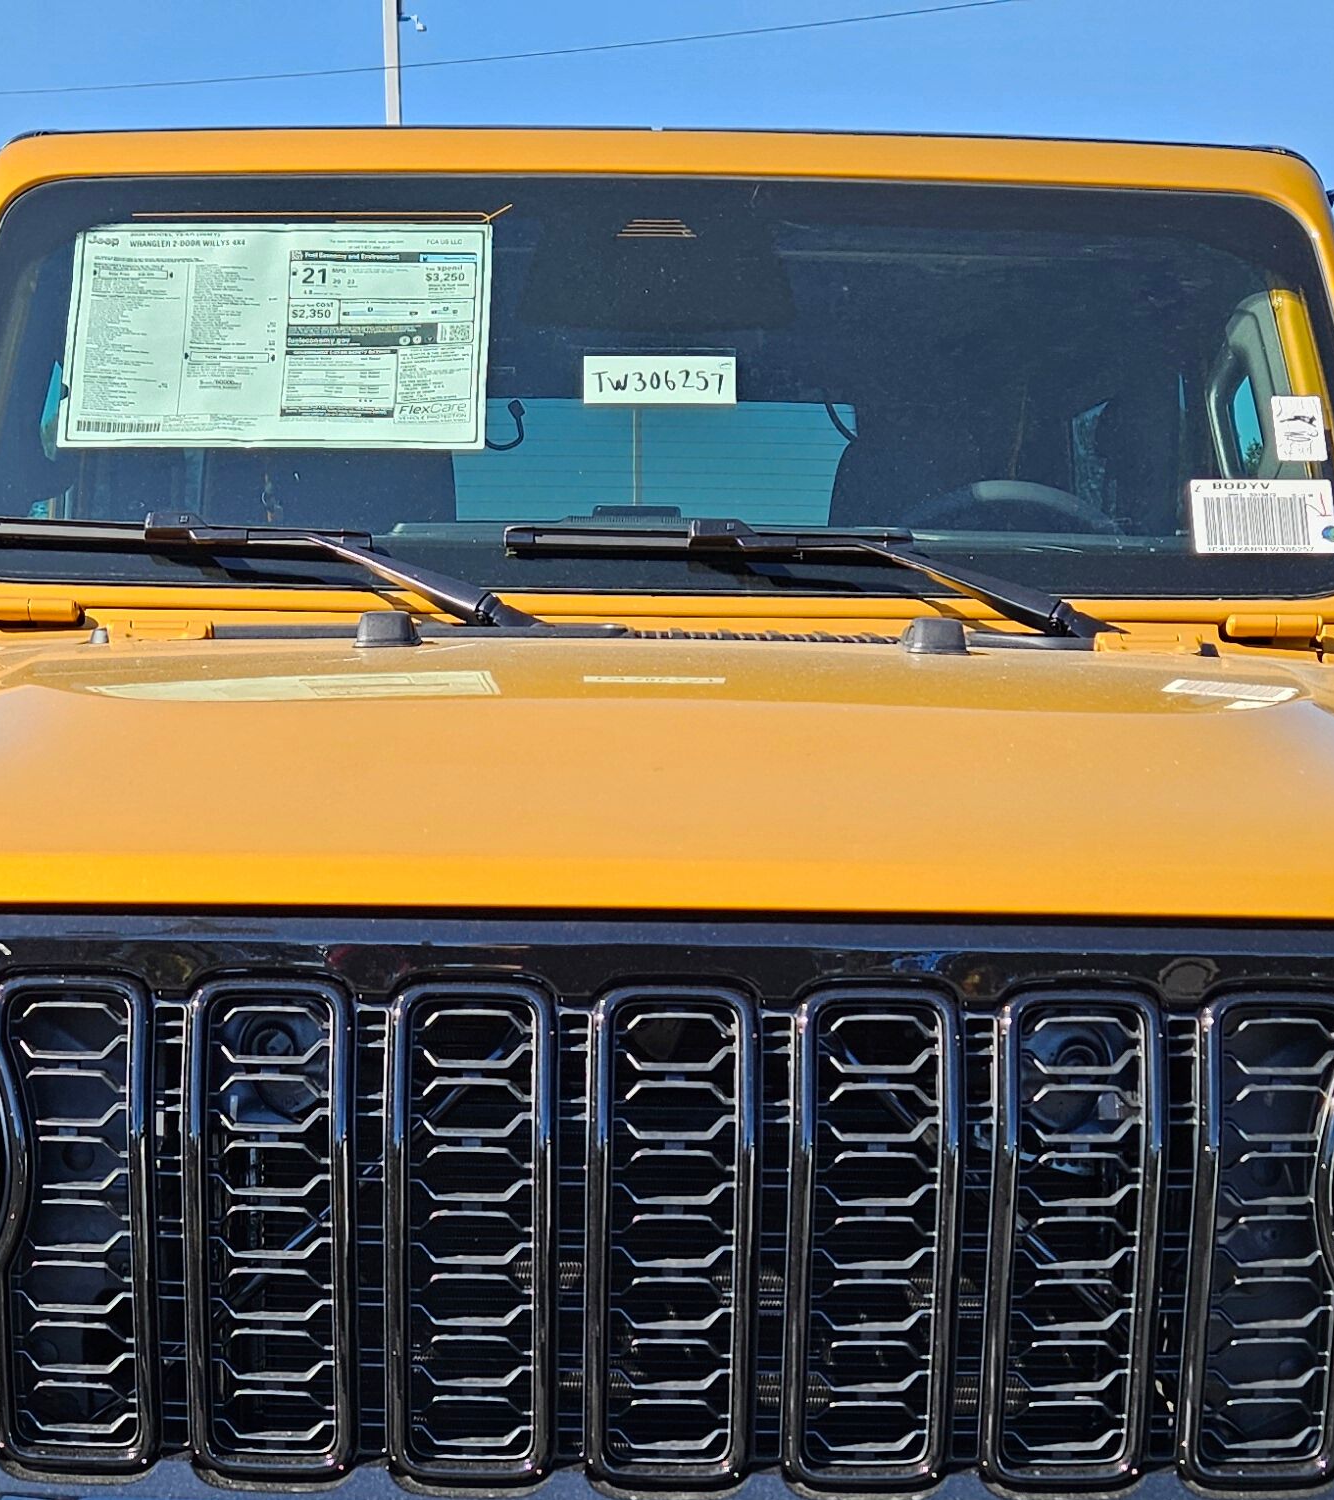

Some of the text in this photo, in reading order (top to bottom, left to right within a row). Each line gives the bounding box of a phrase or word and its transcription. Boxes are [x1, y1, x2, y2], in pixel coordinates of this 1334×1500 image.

[129, 239, 171, 248] WRANGLER
[172, 239, 201, 248] 2-DOOR
[202, 239, 230, 247] WILLYS
[301, 267, 328, 284] 21
[425, 272, 465, 283] $3,250
[291, 309, 332, 320] $2,350
[591, 369, 725, 395] TW306257
[398, 402, 467, 415] FlexCare
[1212, 482, 1271, 490] BODYV
